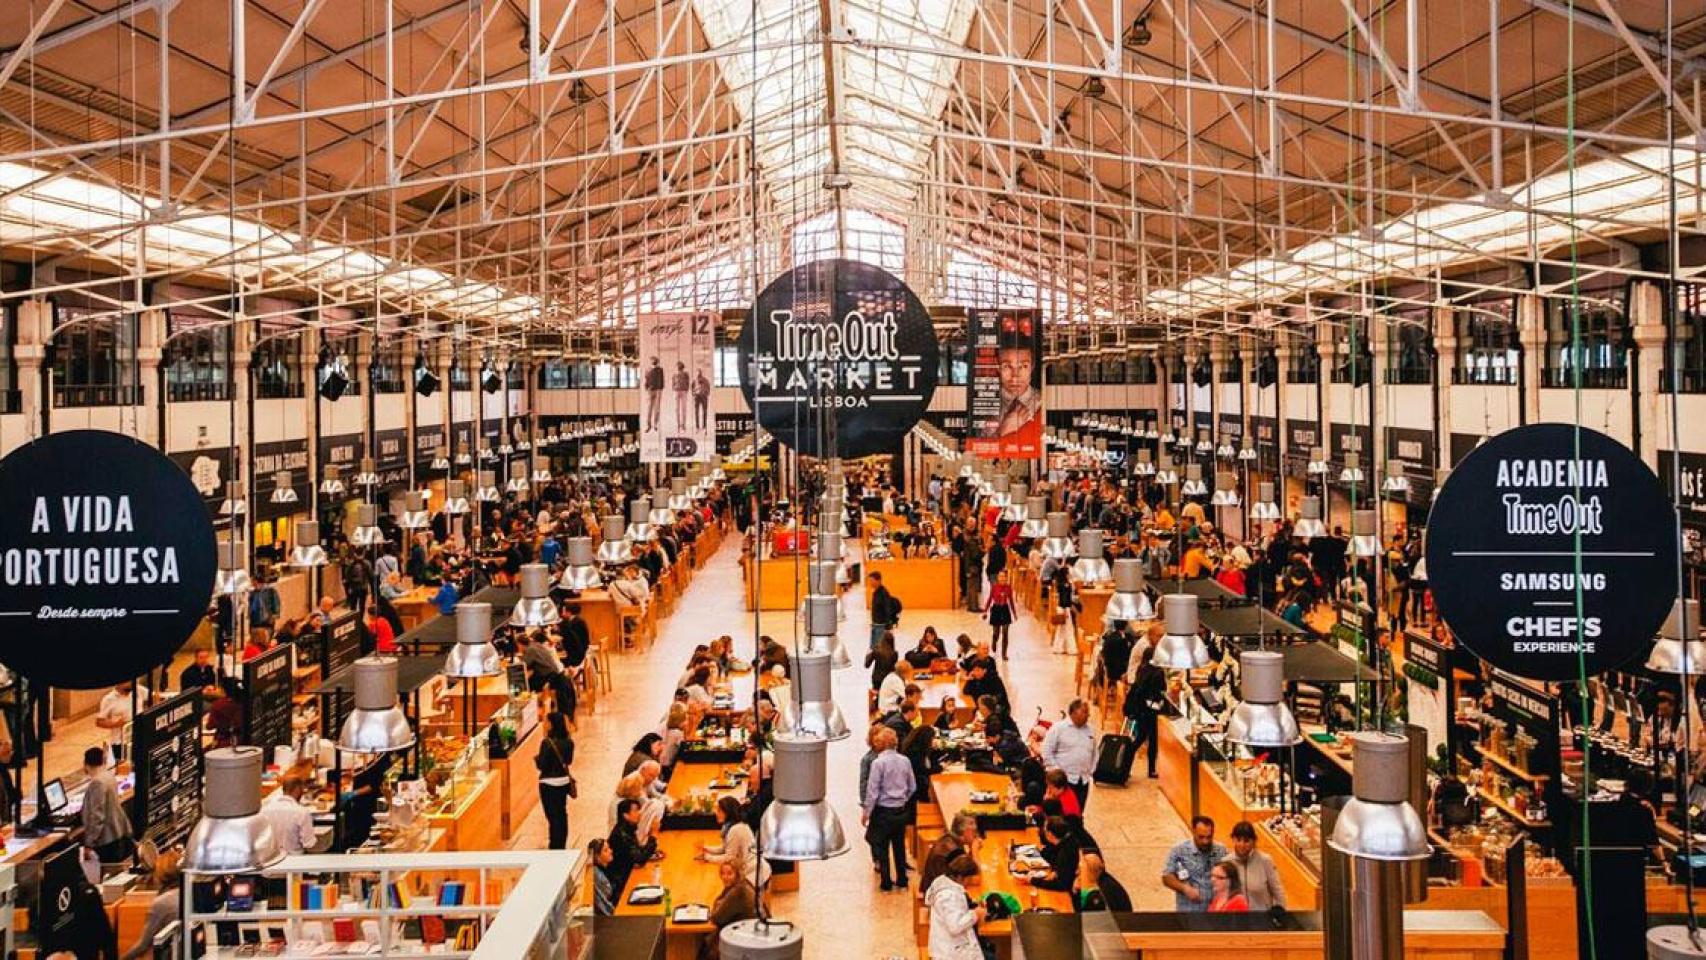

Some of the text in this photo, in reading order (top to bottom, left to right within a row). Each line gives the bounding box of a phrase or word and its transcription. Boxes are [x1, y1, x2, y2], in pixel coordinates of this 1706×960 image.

[691, 315, 709, 335] 12
[756, 367, 922, 390] MARKET
[809, 395, 868, 408] LISBOA
[1496, 459, 1608, 488] ACADEMIA
[31, 495, 134, 534] A VIDA
[0, 546, 180, 586] ORTUGUESA
[1500, 573, 1606, 591] SAMSUNG
[37, 605, 128, 620] Desde sempre
[1513, 641, 1595, 653] EXPERIENCE
